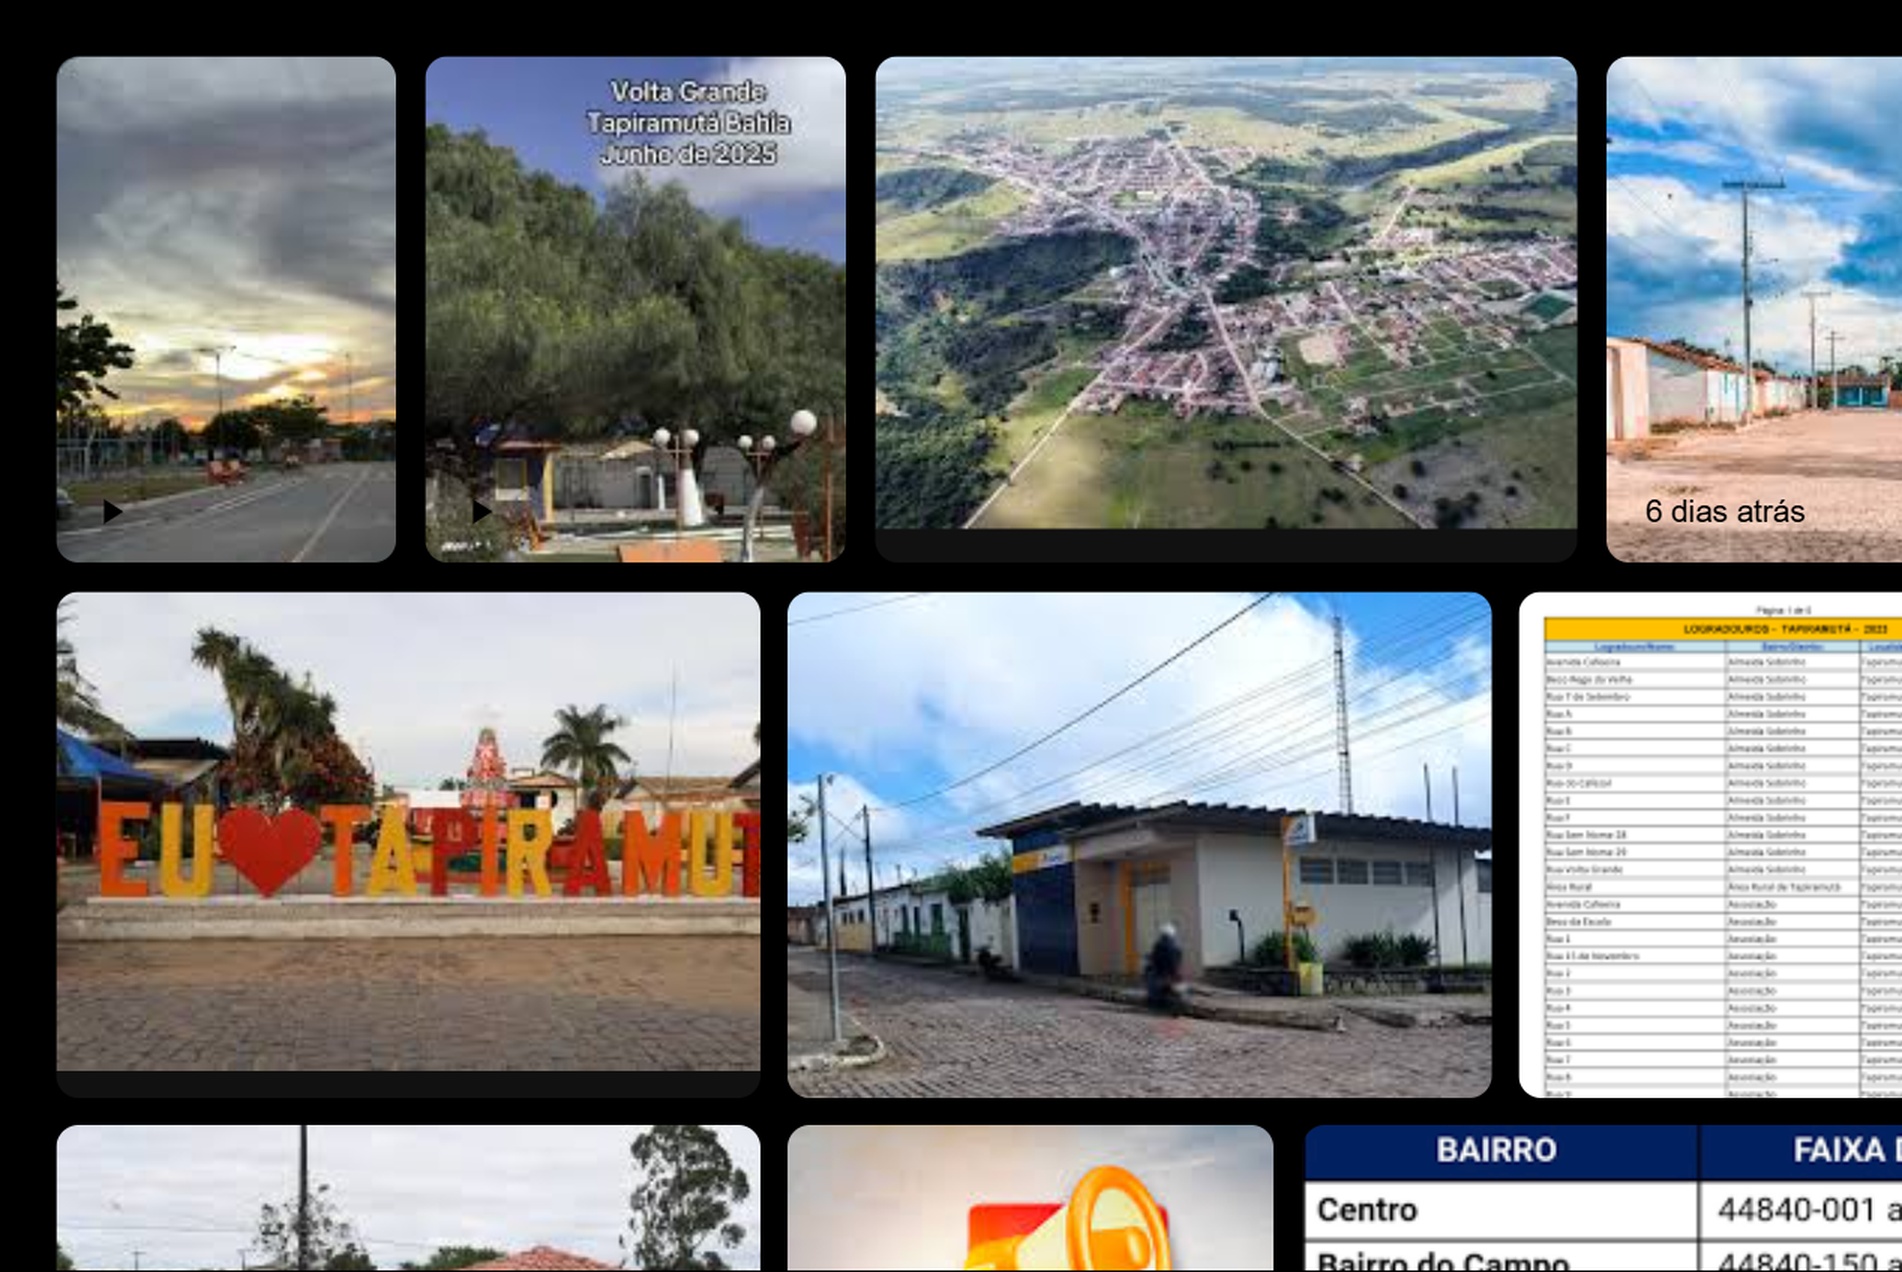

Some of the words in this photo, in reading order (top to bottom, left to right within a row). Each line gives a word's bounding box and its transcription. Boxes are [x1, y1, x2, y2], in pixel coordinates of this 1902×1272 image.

[1683, 624, 1770, 635] LOGRADOUROS
[99, 801, 215, 897] EU
[1436, 1136, 1557, 1163] BAIRRO
[1794, 1136, 1887, 1163] FAIXA
[1317, 1197, 1418, 1222] Centro
[1718, 1196, 1873, 1222] 44840-001
[1318, 1251, 1408, 1271] Bairro
[1417, 1251, 1454, 1271] do
[1718, 1253, 1878, 1271] 44840-150
